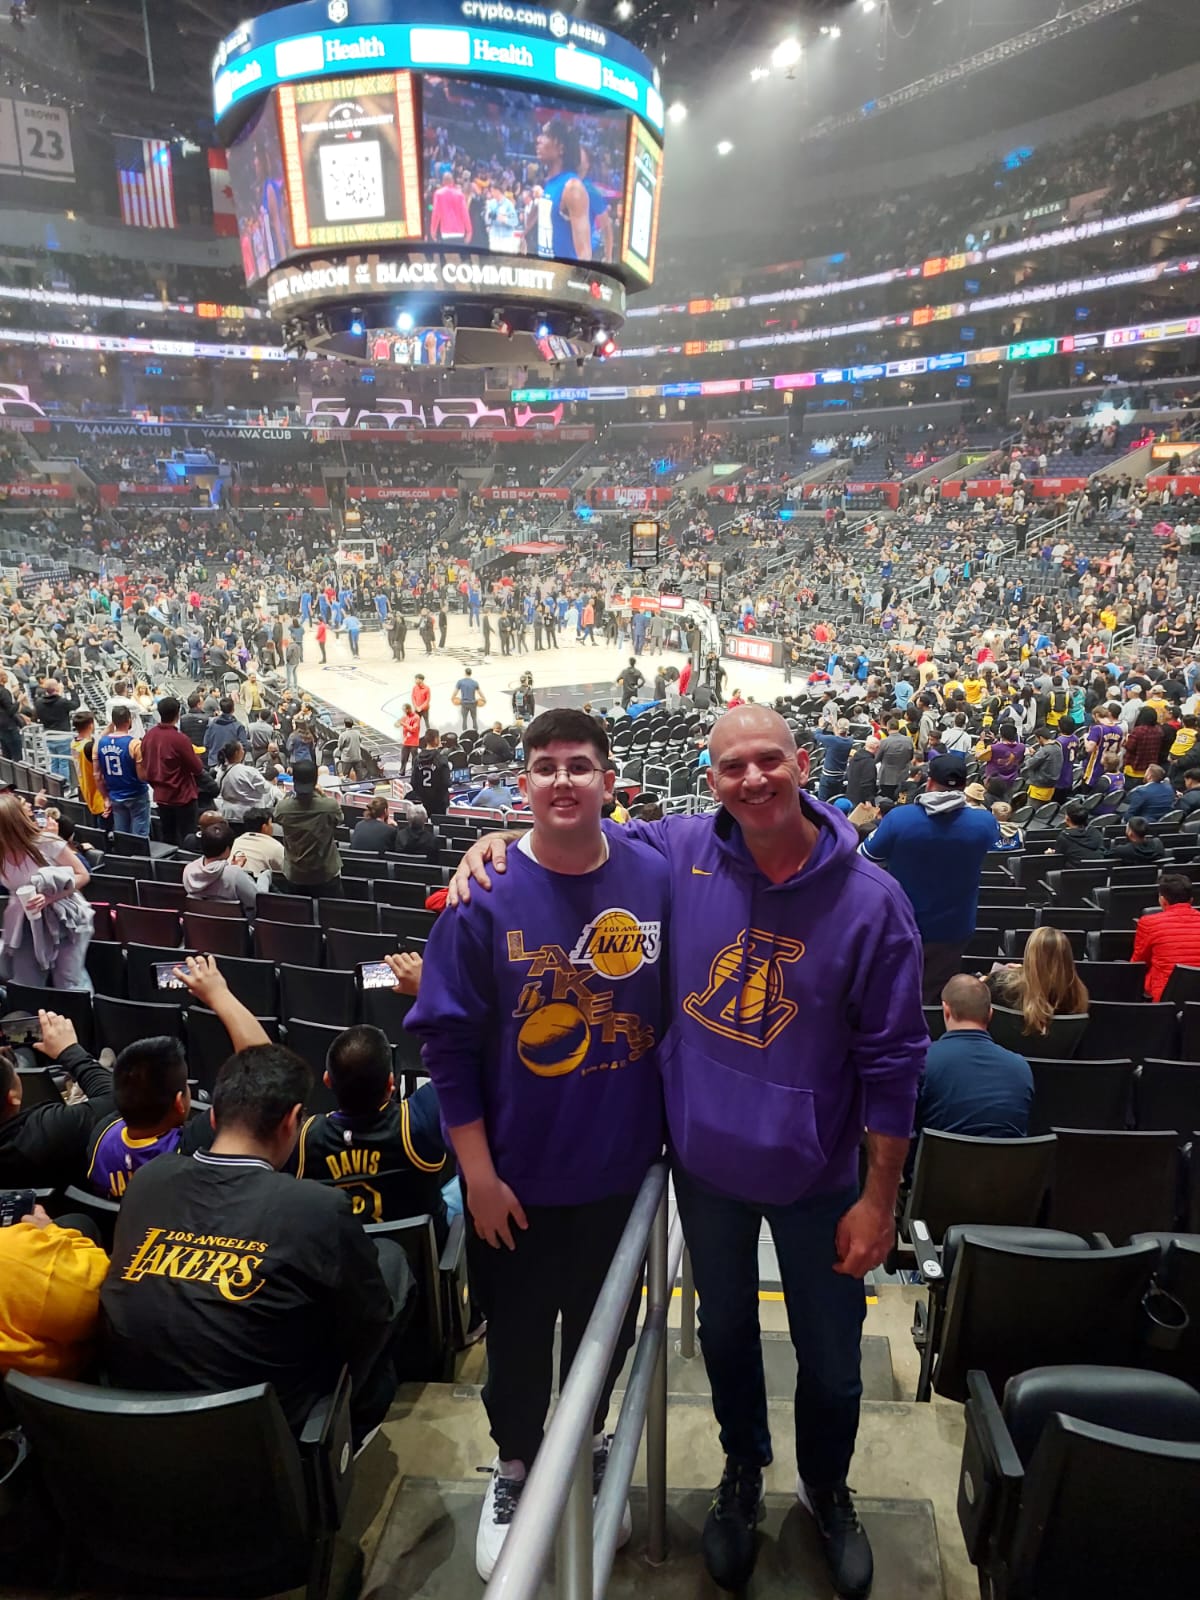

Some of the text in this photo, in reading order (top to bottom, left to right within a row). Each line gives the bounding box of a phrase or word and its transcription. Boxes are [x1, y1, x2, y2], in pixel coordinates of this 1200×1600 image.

[462, 2, 547, 28] crypto.com
[569, 22, 606, 47] ARENA
[325, 36, 385, 62] Health
[473, 39, 534, 67] Health
[27, 127, 65, 161] 23
[1031, 203, 1061, 218] DELTA
[289, 265, 350, 294] PASSION
[376, 262, 438, 283] BLACK
[442, 264, 556, 291] COMMUNITY
[140, 426, 172, 437] CLUB
[262, 430, 292, 440] CLUB
[104, 755, 123, 776] 13
[422, 769, 432, 787] 2
[603, 924, 658, 933] LOS ANGELES
[571, 926, 659, 959] LAKERS
[506, 929, 655, 1062] LAKERS
[326, 1149, 381, 1180] DAVIS
[164, 1230, 269, 1253] LOS ANGELES
[120, 1227, 267, 1301] LAKERS
